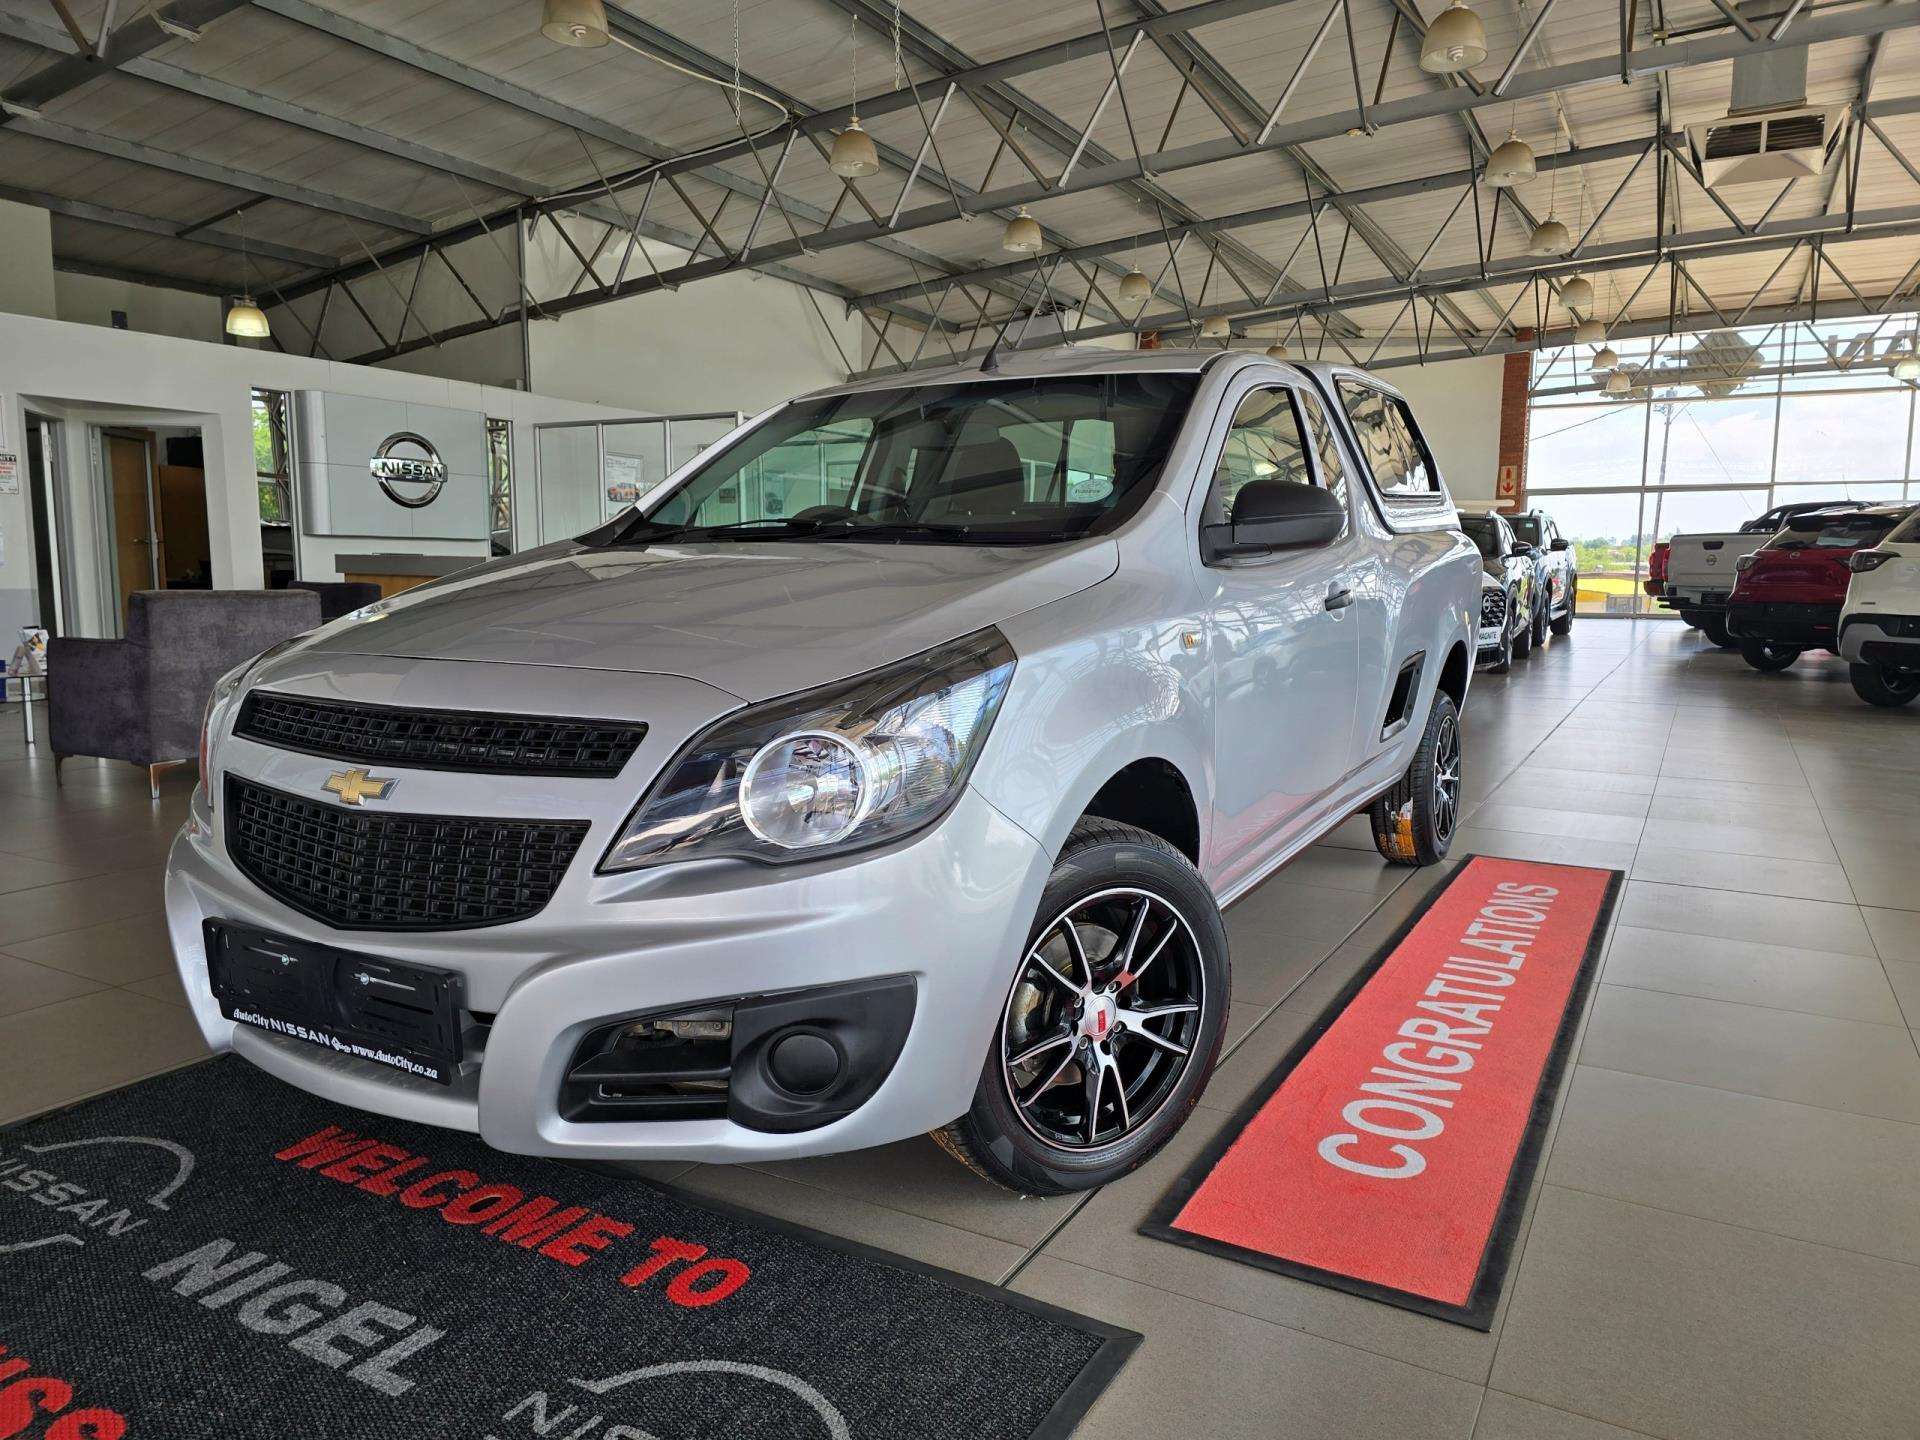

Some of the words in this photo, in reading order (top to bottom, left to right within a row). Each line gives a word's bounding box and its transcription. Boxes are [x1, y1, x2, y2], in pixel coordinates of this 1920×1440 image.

[381, 461, 443, 478] NISSAN
[233, 1008, 270, 1029] AutoCity
[269, 1017, 331, 1046] NISSAN
[351, 1044, 438, 1079] www.AutoCity.co.za
[1317, 883, 1560, 1179] CONGRATULATIONS
[274, 1124, 635, 1268] WELCOME
[621, 1236, 751, 1308] TO
[142, 1237, 448, 1397] NIGEL
